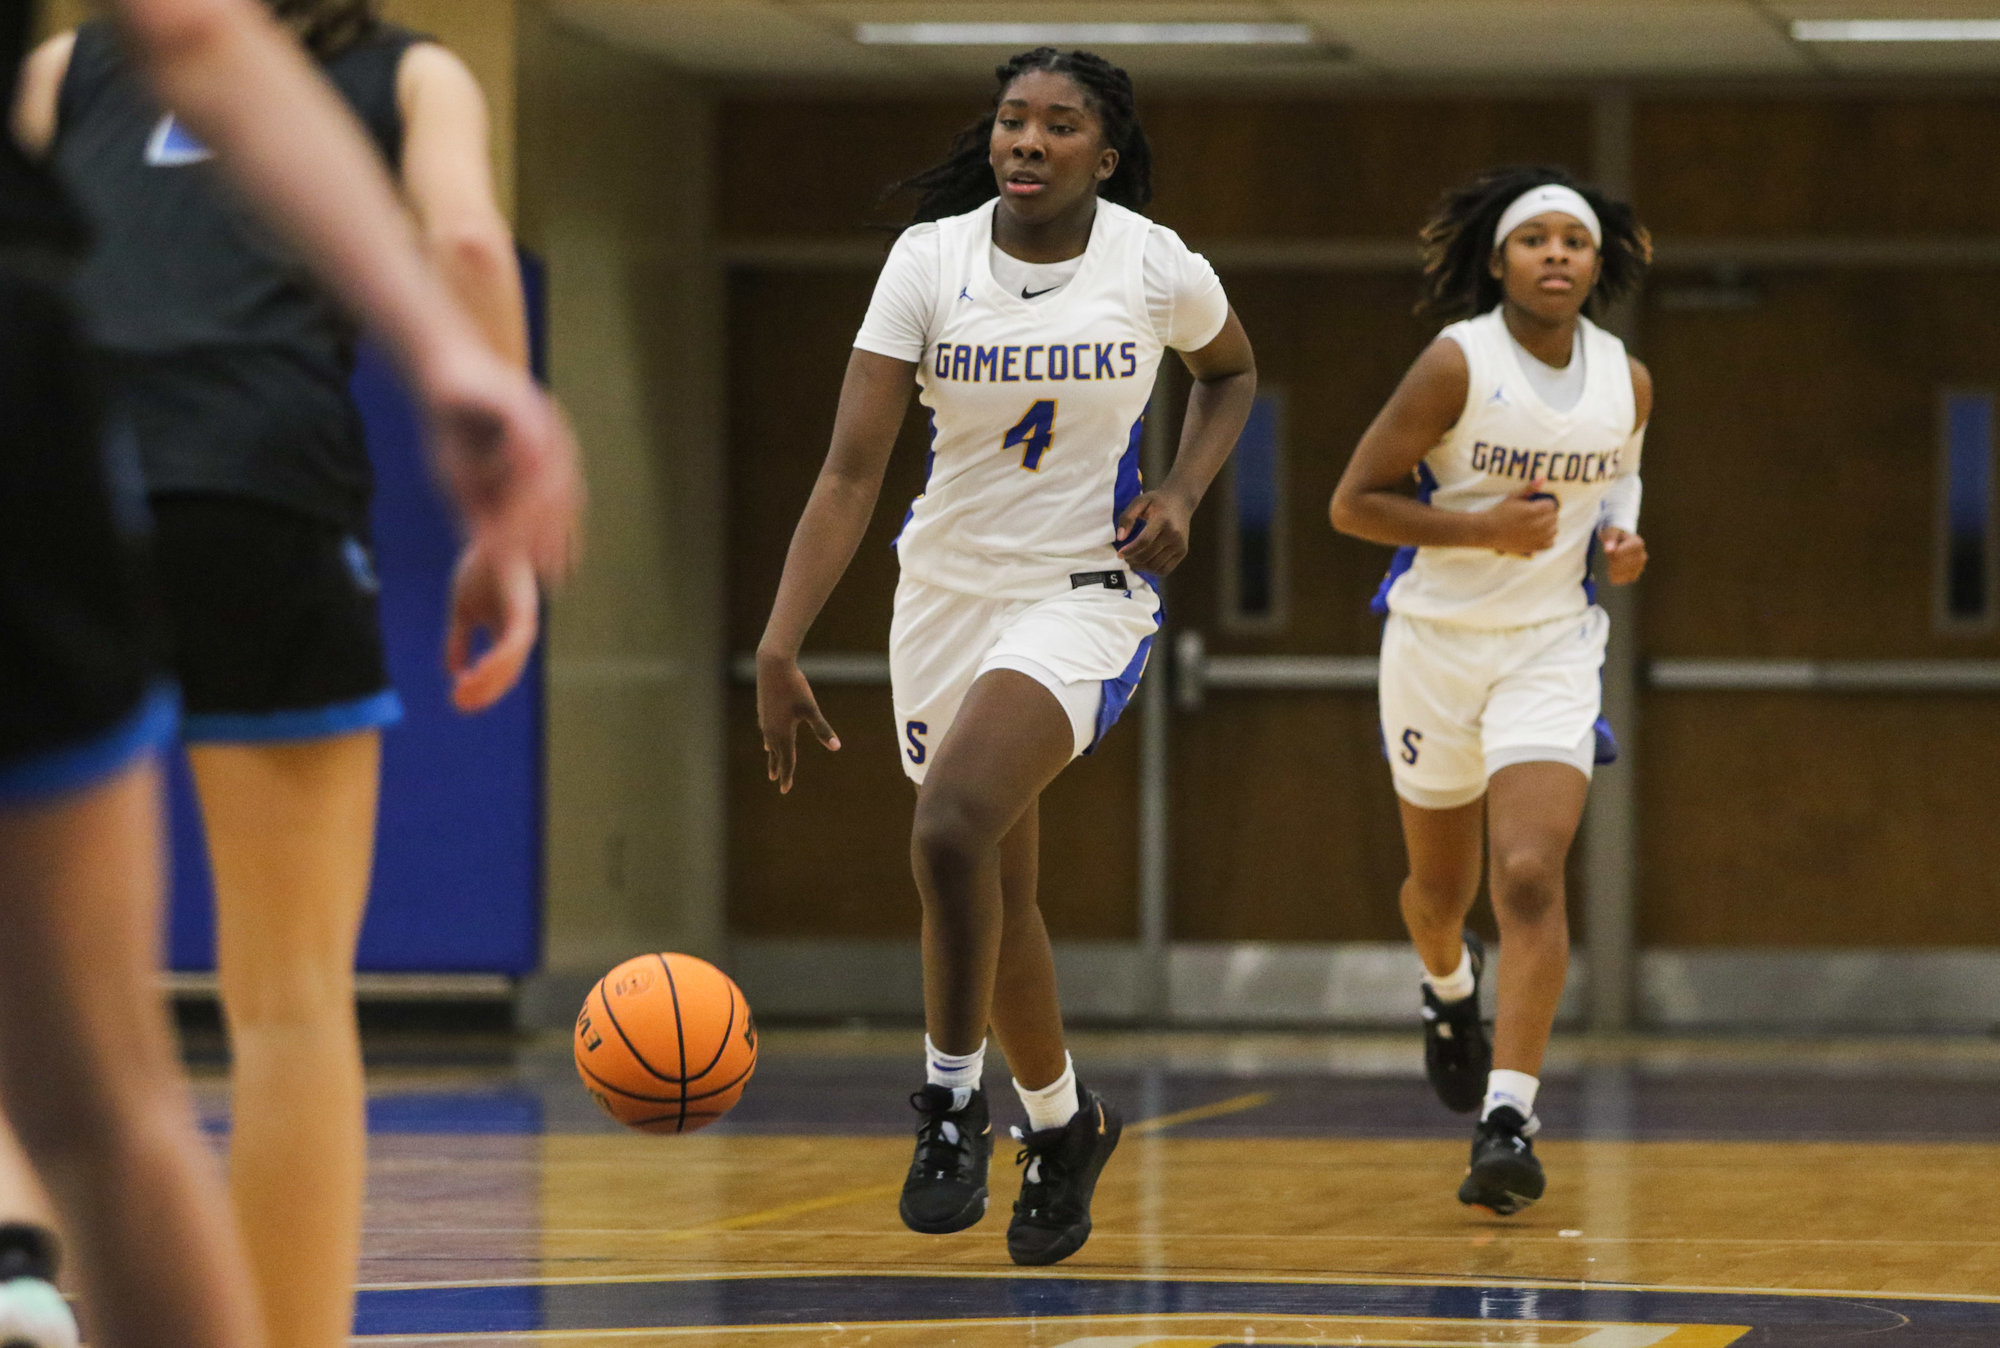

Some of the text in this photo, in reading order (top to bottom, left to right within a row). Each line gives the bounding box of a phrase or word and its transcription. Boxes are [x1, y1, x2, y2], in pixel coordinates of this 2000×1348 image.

[935, 341, 1137, 382] GAMECOCKS
[1001, 398, 1058, 473] 4
[1109, 573, 1119, 585] S
[905, 719, 928, 767] S
[1401, 728, 1422, 767] S
